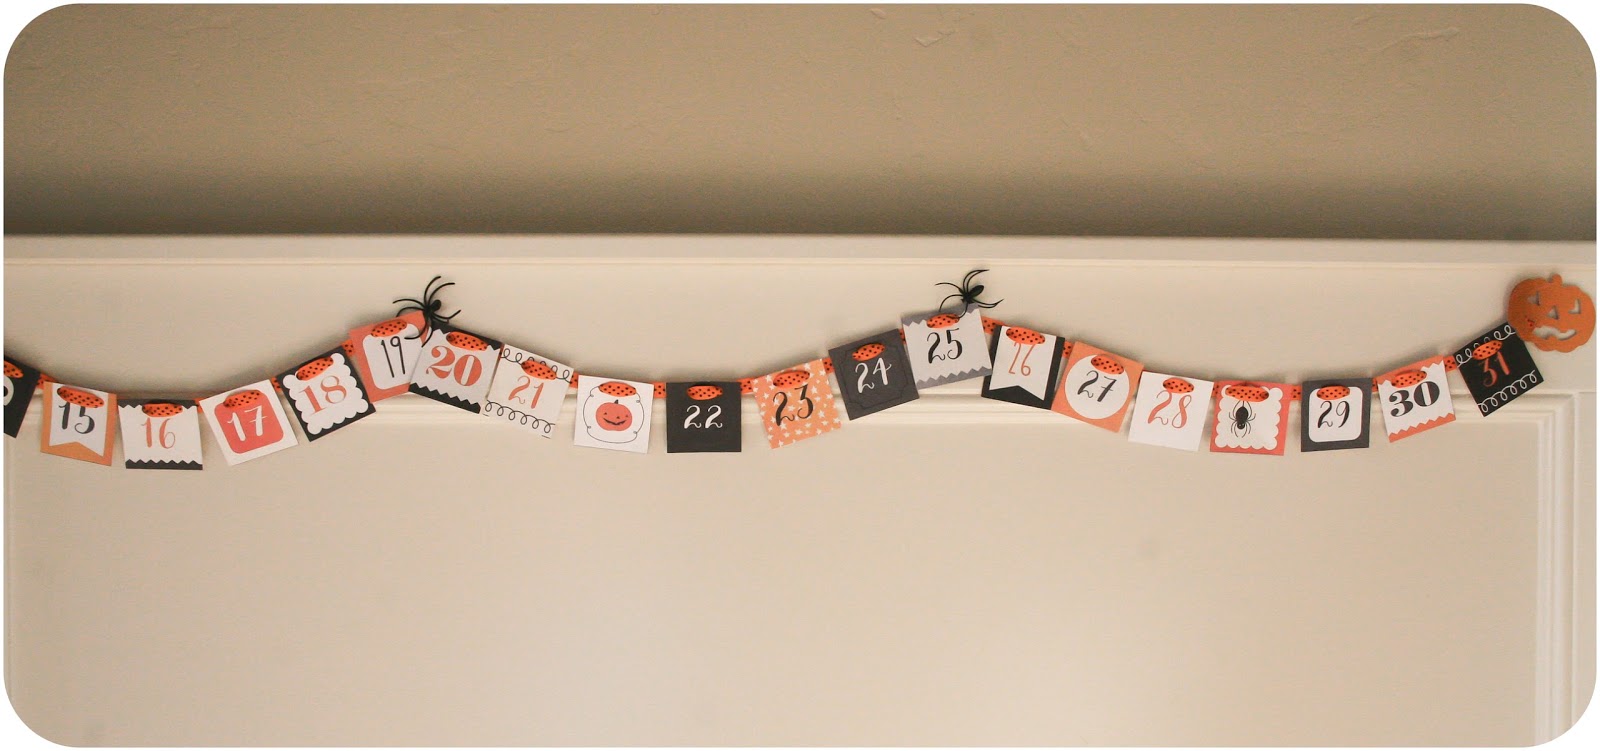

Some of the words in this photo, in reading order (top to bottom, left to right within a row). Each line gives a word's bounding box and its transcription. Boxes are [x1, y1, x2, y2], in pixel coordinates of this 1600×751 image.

[380, 336, 406, 378] 19
[927, 328, 963, 364] 25
[1008, 341, 1036, 376] 26
[426, 345, 482, 387] 20
[855, 357, 892, 394] 24
[1478, 351, 1511, 387] 31
[299, 375, 347, 416] 18
[508, 375, 545, 409] 21
[1077, 370, 1117, 402] 27
[1389, 380, 1440, 417] 30
[58, 402, 95, 434] 15
[684, 404, 723, 429] 22
[772, 384, 814, 426] 23
[1148, 390, 1192, 429] 28
[1317, 400, 1350, 429] 29
[141, 417, 176, 449] 16
[227, 405, 268, 442] 17
